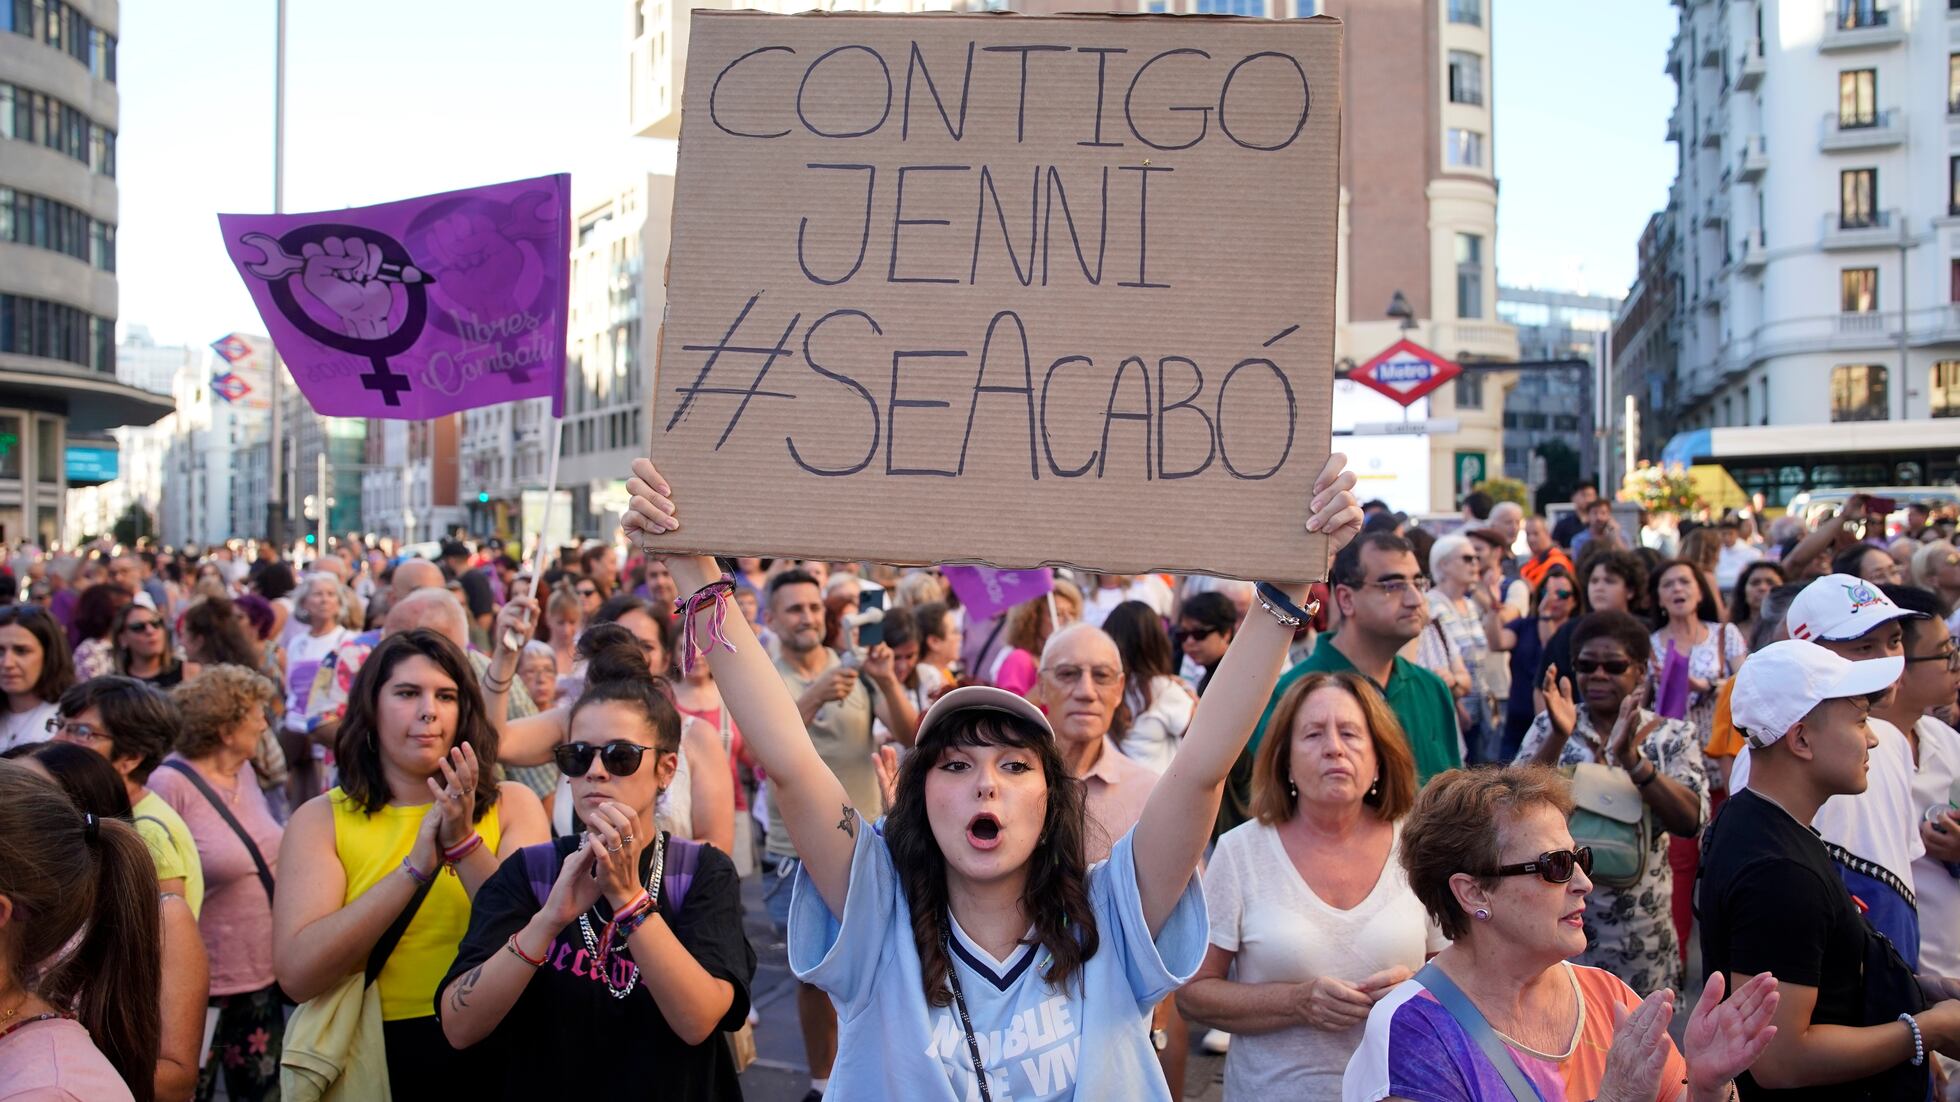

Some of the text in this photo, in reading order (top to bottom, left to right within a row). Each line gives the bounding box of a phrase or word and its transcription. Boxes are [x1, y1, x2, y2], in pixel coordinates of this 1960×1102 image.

[709, 41, 1311, 151] CONTIGO
[798, 162, 1175, 288] JENNI
[448, 308, 543, 363] Libres
[1380, 363, 1430, 381] Metro
